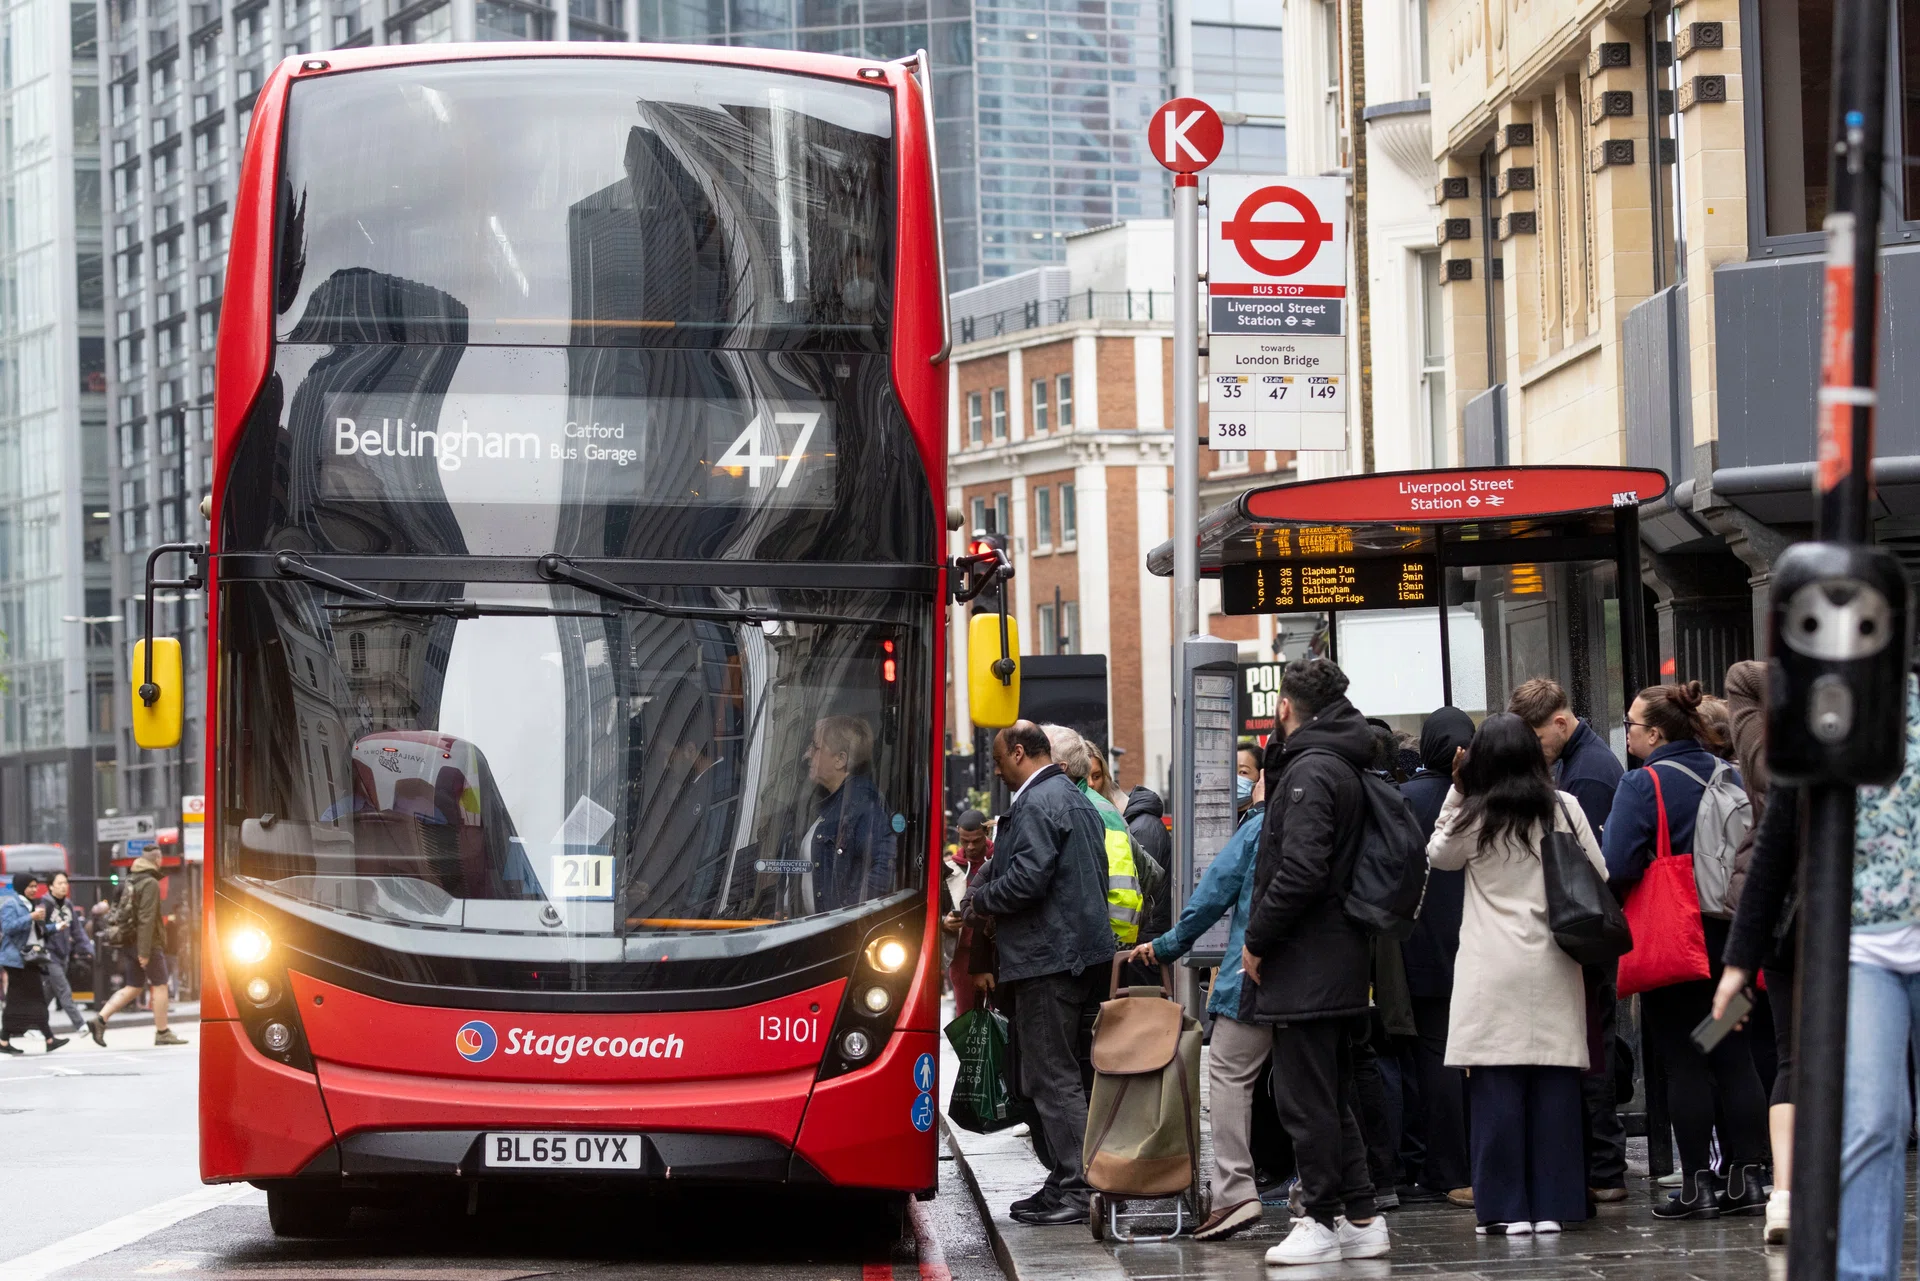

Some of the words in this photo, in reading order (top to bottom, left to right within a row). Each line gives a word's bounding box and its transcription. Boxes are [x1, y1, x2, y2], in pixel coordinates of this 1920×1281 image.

[1164, 110, 1208, 162] K
[1252, 286, 1273, 294] BUS
[1277, 286, 1304, 295] STOP
[1228, 302, 1284, 317] Liverpool
[1288, 303, 1326, 314] Street
[1237, 315, 1281, 326] Station
[1236, 355, 1279, 365] London
[1283, 355, 1320, 368] Bridge
[1223, 385, 1242, 398] 35
[1269, 386, 1288, 400] 47
[1310, 386, 1336, 399] 149
[564, 422, 624, 439] Catford
[1218, 423, 1247, 437] 388
[335, 417, 541, 471] Bellingham
[714, 412, 822, 488] 47
[550, 445, 577, 460] Bus
[584, 444, 637, 467] Garage
[1399, 480, 1466, 496] Liverpool
[1470, 478, 1514, 491] Street
[1411, 496, 1462, 510] Station
[1257, 569, 1263, 578] 1
[1280, 568, 1292, 577] 35
[1302, 567, 1337, 577] Clapham
[1339, 566, 1355, 575] Jun
[1402, 563, 1423, 572] 1min
[1257, 578, 1264, 587] 5
[1280, 578, 1293, 586] 35
[1302, 577, 1337, 586] Clapham
[1339, 575, 1355, 584] Jun
[1402, 572, 1424, 581] 9min
[1258, 588, 1264, 597] 6
[1280, 587, 1293, 595] 47
[1302, 586, 1350, 596] Bellingham
[1398, 582, 1424, 591] 13min
[1258, 597, 1265, 606] 7
[1275, 597, 1294, 605] 388
[1303, 595, 1333, 604] London
[1335, 594, 1365, 603] Bridge
[1398, 591, 1425, 600] 15min
[563, 859, 600, 887] 211
[759, 1015, 818, 1043] 13101
[504, 1027, 684, 1064] Stagecoach
[496, 1137, 567, 1162] BL65
